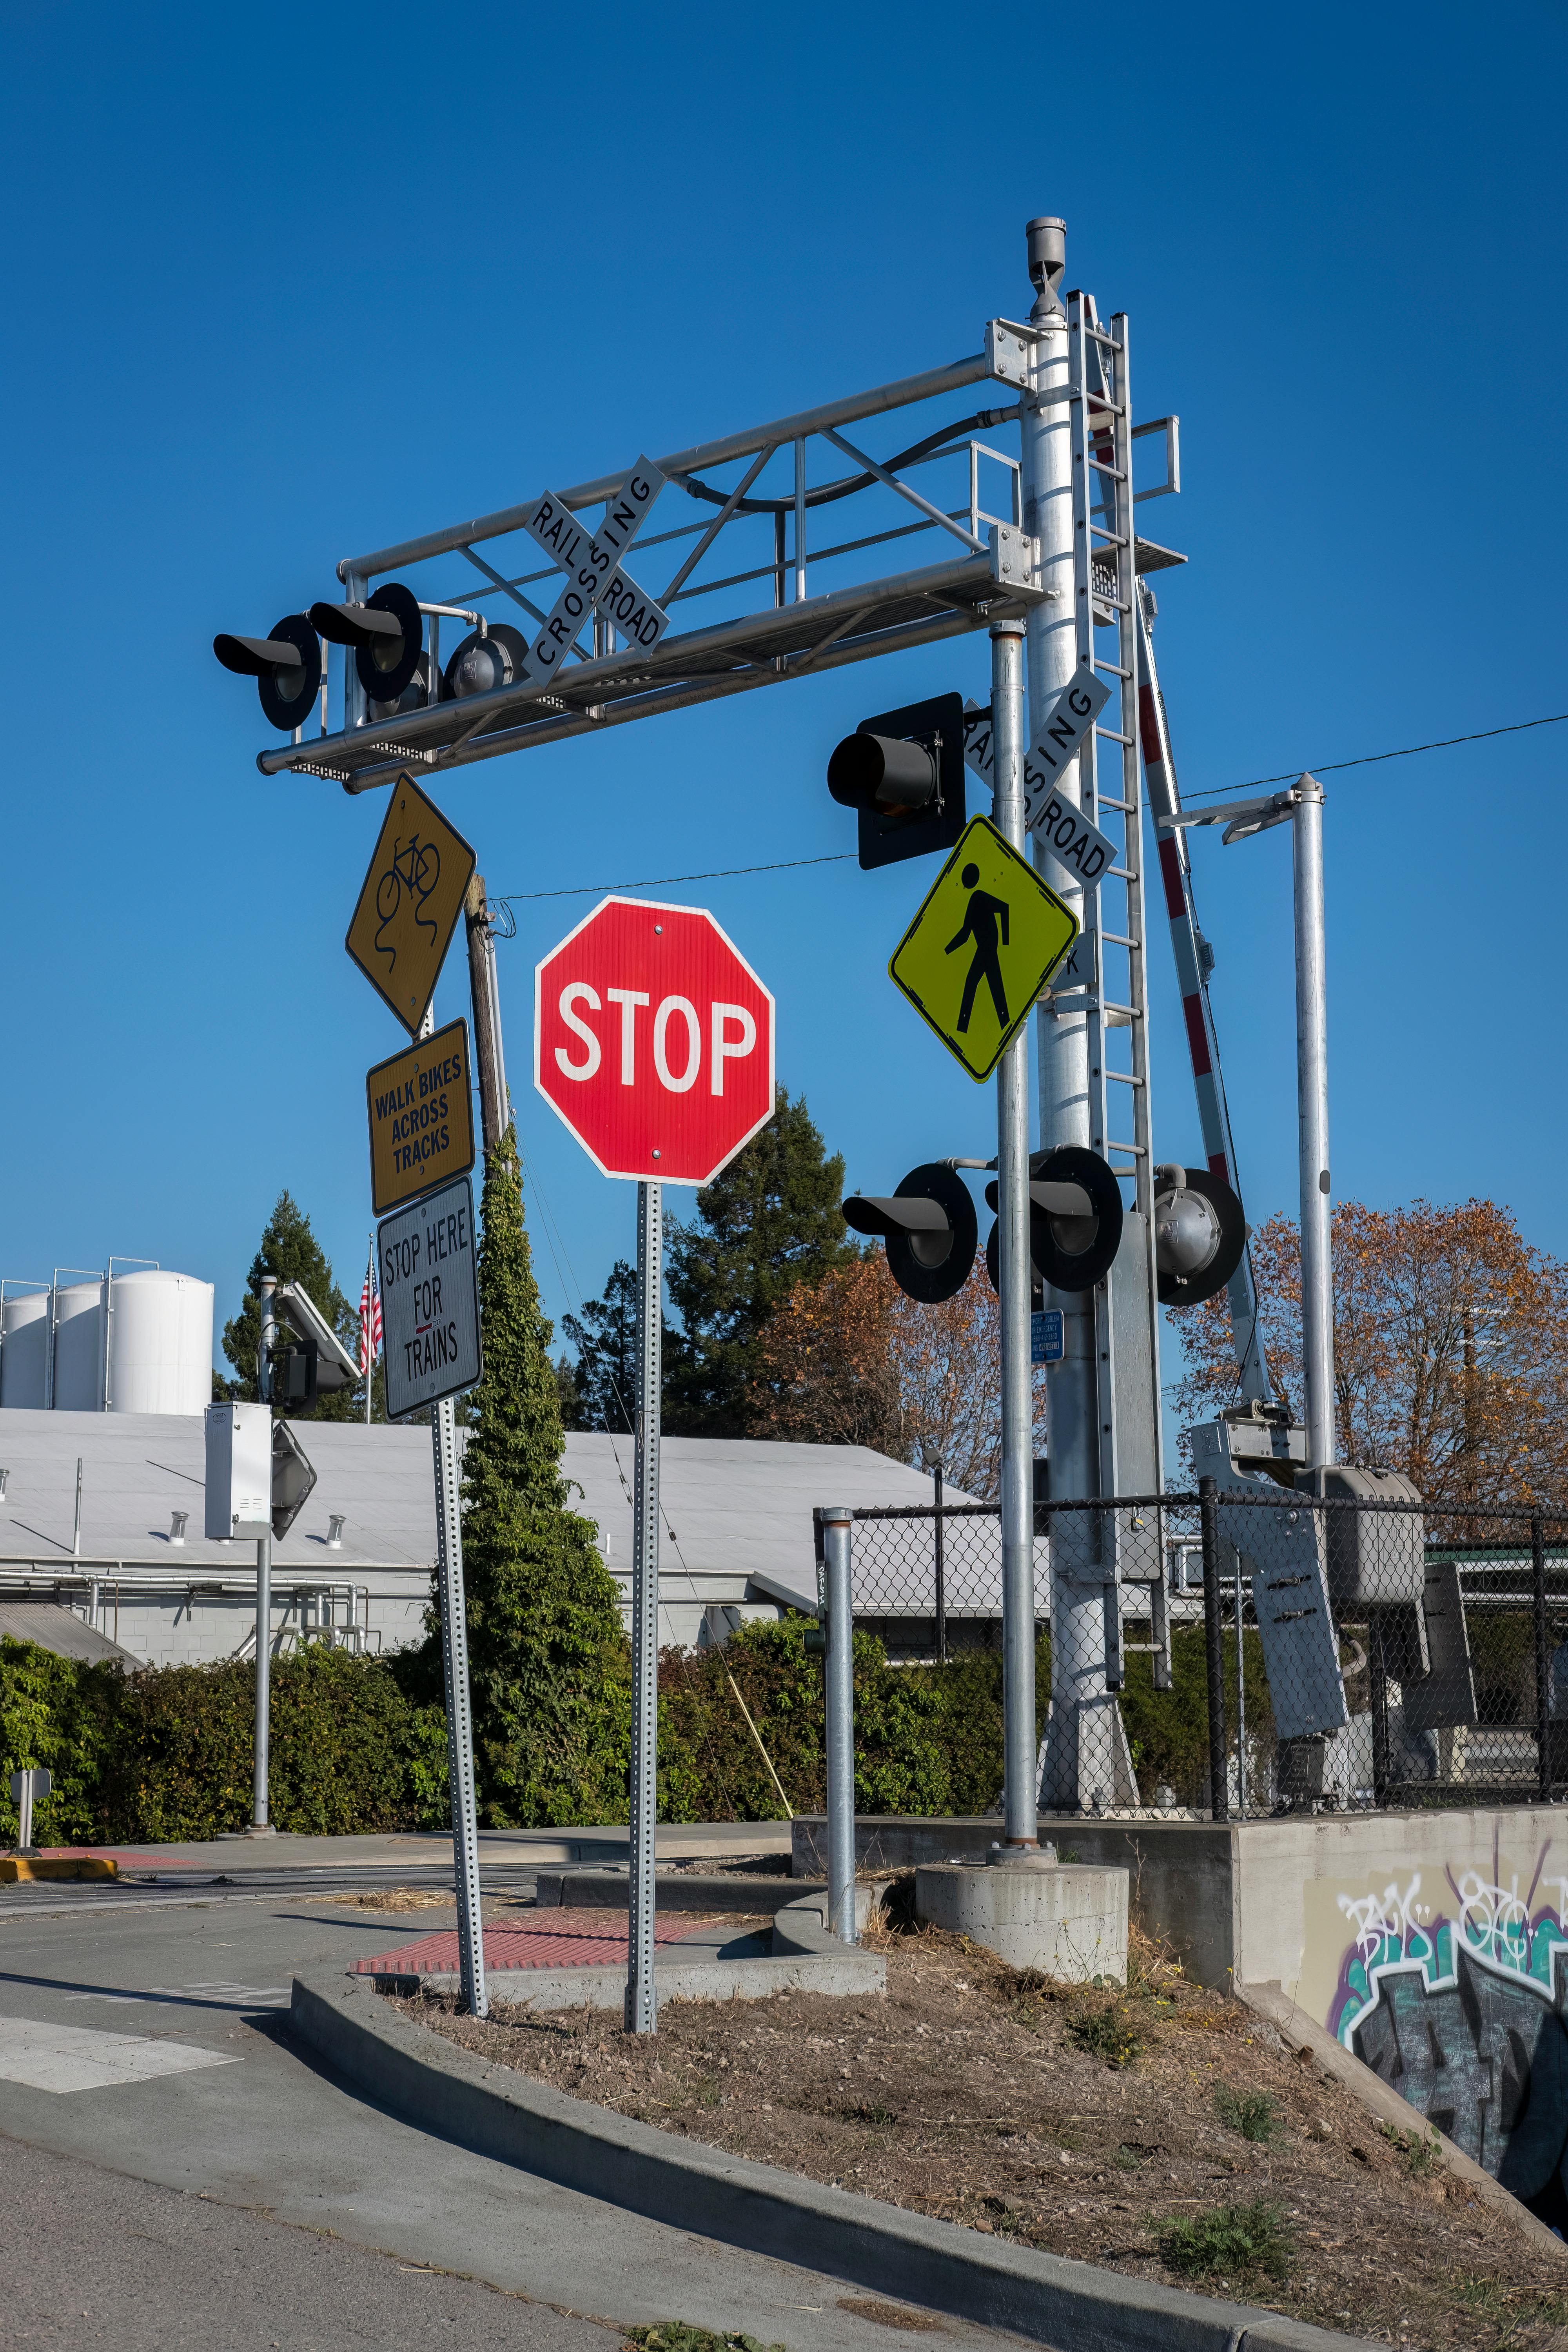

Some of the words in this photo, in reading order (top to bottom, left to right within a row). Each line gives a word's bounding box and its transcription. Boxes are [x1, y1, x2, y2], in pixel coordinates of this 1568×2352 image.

[532, 501, 581, 569] RAIL
[603, 576, 659, 646] ROAD
[537, 476, 650, 665] CROSSING
[1038, 799, 1105, 878] ROAD
[554, 982, 757, 1096] STOP
[375, 1078, 415, 1121] WALK
[419, 1054, 461, 1099] BIKES
[392, 1093, 448, 1145] ACROSS
[393, 1124, 450, 1174] TRACKS
[385, 1232, 420, 1287] STOP
[427, 1207, 468, 1267] HERE
[414, 1275, 443, 1325] FOR
[1045, 1315, 1059, 1323] ROBLEM
[404, 1321, 458, 1382] TRAINS
